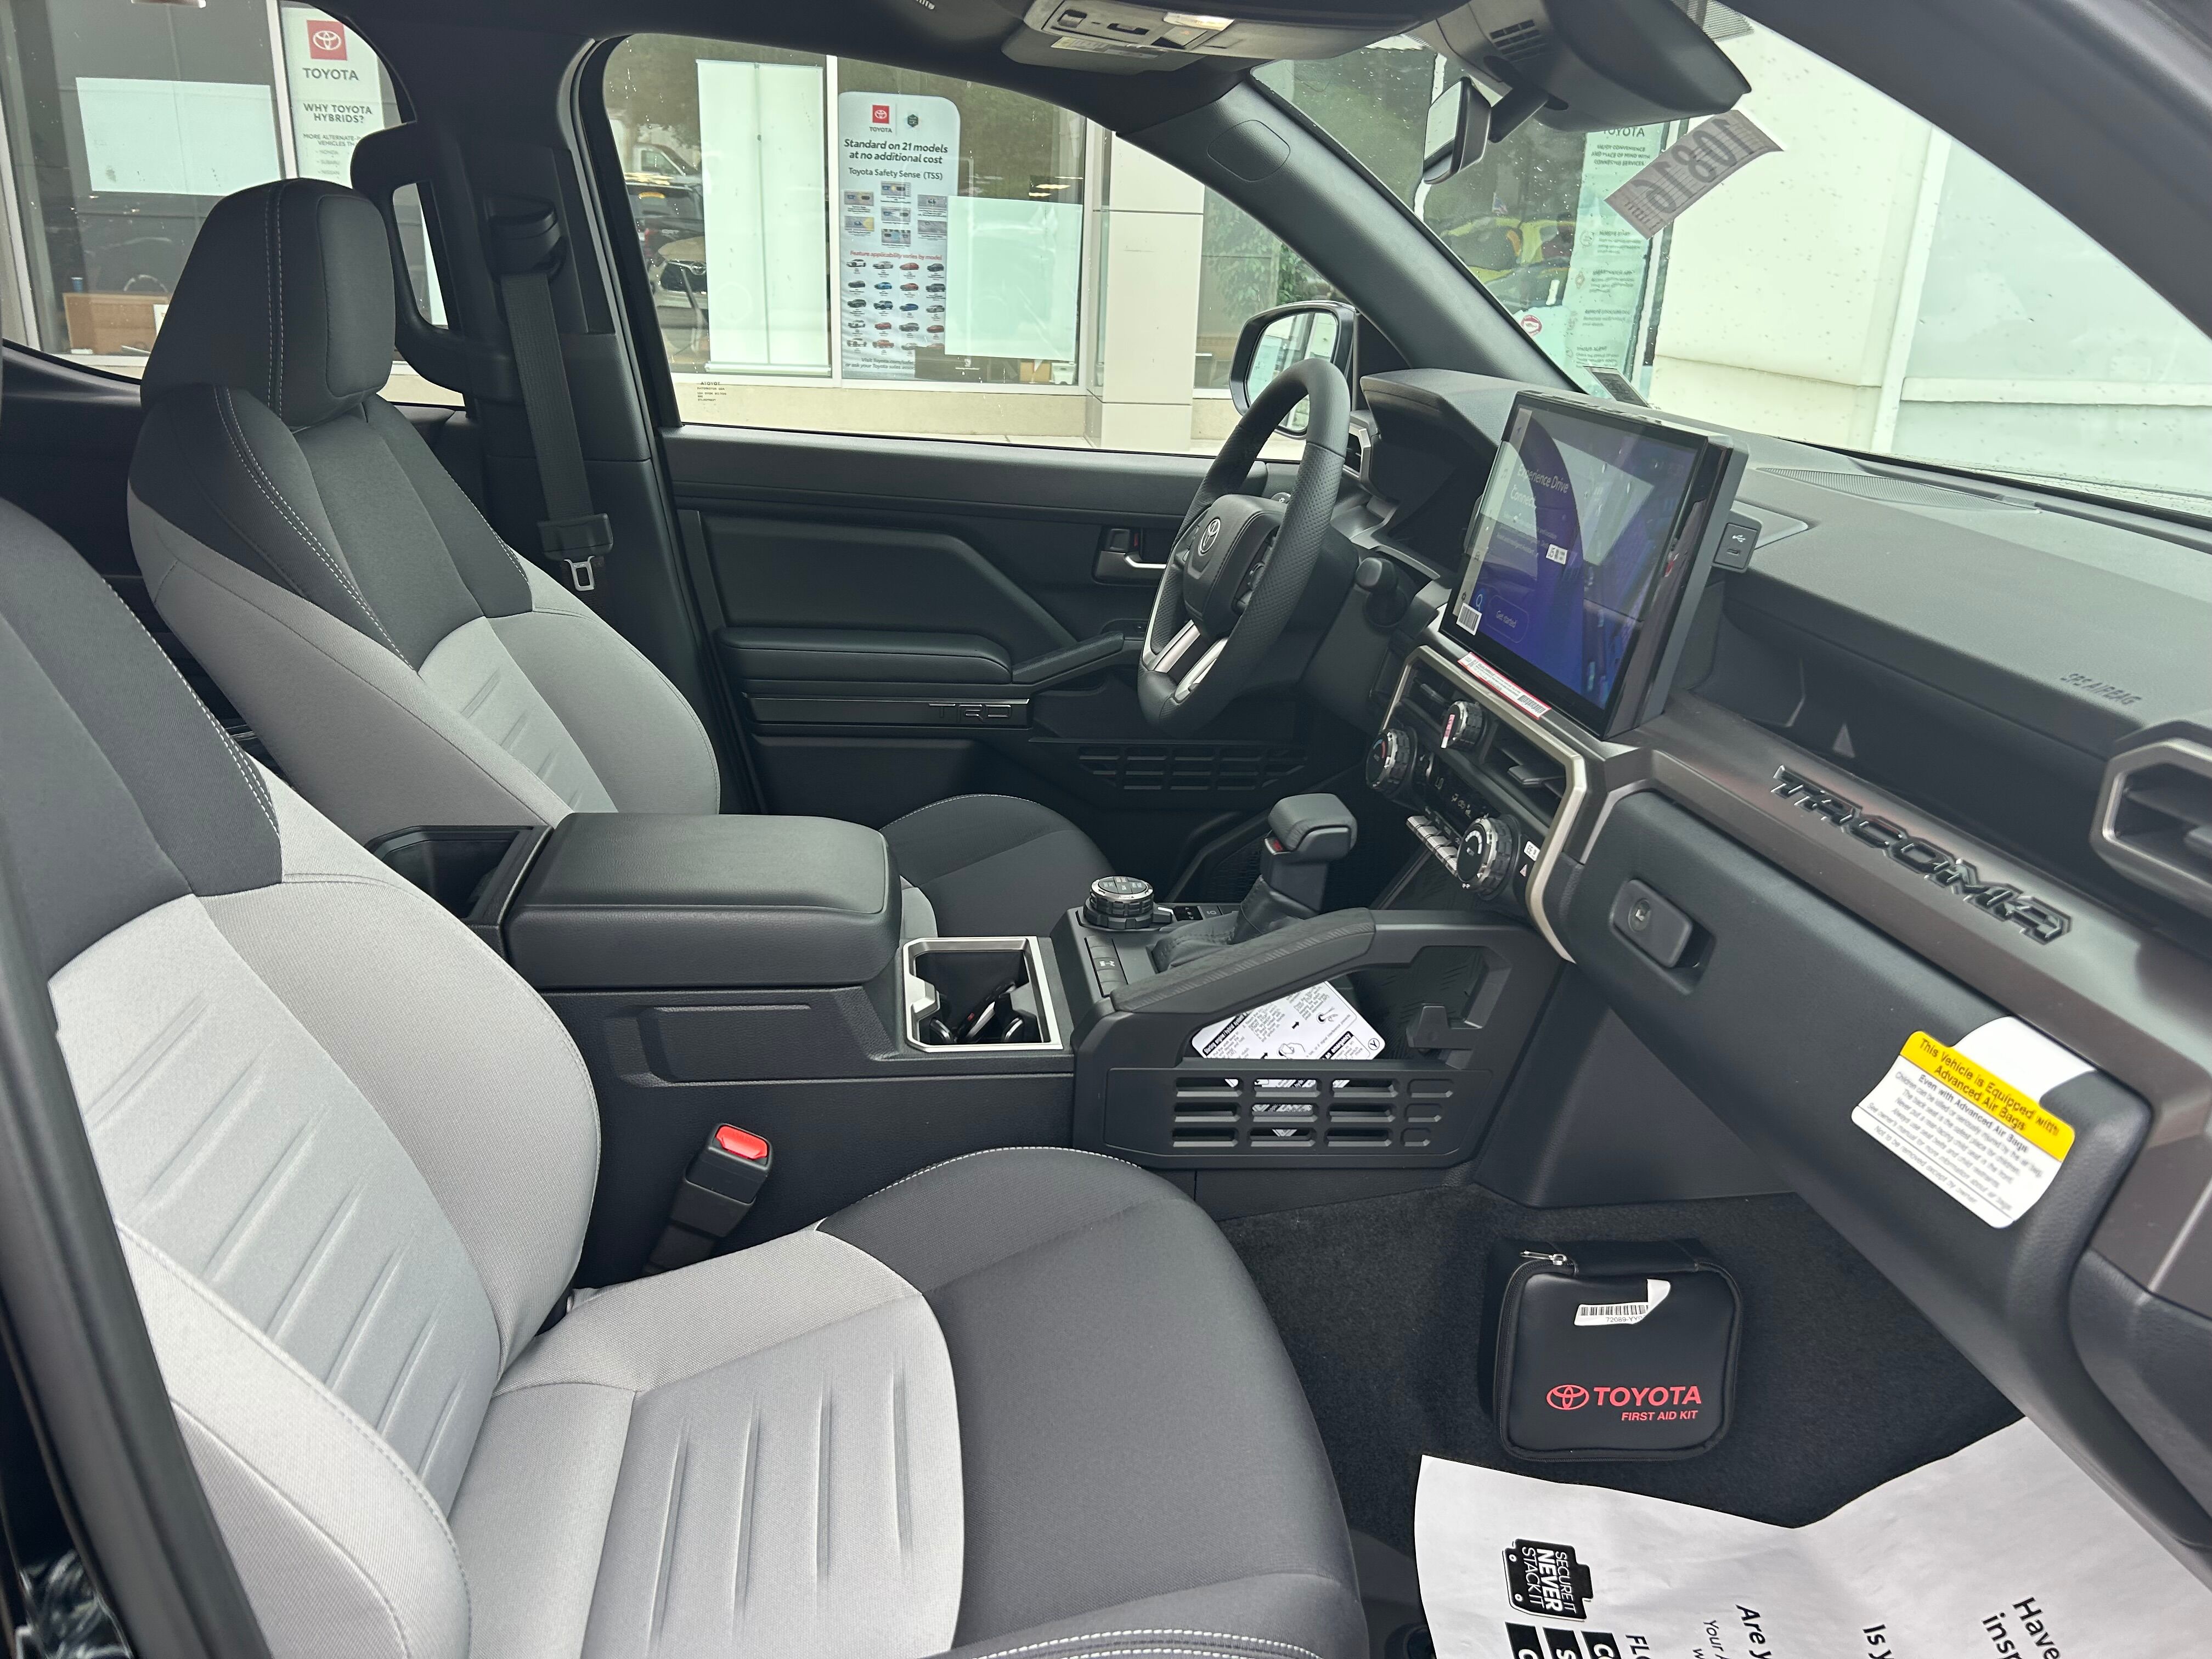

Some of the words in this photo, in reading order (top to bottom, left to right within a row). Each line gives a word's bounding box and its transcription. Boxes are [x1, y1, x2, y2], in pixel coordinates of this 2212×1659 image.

[302, 67, 359, 81] TOYOTA
[303, 103, 328, 111] WHY
[331, 104, 373, 114] TOYOTA
[314, 113, 364, 123] HYBRIDS?
[844, 139, 887, 149] Standard
[902, 142, 912, 150] 21
[913, 143, 949, 153] models
[849, 151, 859, 159] at
[874, 152, 921, 162] additional
[923, 156, 943, 164] cost
[848, 167, 873, 176] Toyota
[874, 169, 898, 178] Safety
[923, 172, 943, 180] (TSS)
[1517, 467, 1551, 487] Experience
[1551, 475, 1569, 493] Drive
[2081, 682, 2142, 705] AIRBAG
[1770, 765, 2072, 945] TACOMA
[1331, 1032, 1351, 1053] emergency
[1920, 1039, 1939, 1057] This
[1940, 1052, 1974, 1080] Vehicle
[1974, 1074, 1985, 1087] is
[1985, 1082, 2034, 1122] Equipped
[2035, 1114, 2059, 1136] with
[1935, 1065, 1982, 1101] Advanced
[1983, 1097, 1997, 1111] Air
[1999, 1108, 2025, 1133] Bags
[1919, 1074, 1937, 1090] Even
[1938, 1087, 1954, 1102] with
[1955, 1099, 1992, 1128] Advanced
[1994, 1125, 2006, 1137] Air
[2006, 1134, 2028, 1154] Bags
[1593, 1386, 1702, 1407] TOYOTA
[1621, 1412, 1655, 1421] FIRST
[1657, 1411, 1677, 1420] AID
[1680, 1410, 1698, 1420] KIT
[1522, 1547, 1541, 1595] STACK
[1537, 1548, 1564, 1612] NEVER
[1555, 1551, 1573, 1601] SECURE
[1530, 1594, 1545, 1609] IT
[1563, 1600, 1577, 1614] IT
[1735, 1604, 1766, 1645] Are
[1862, 1624, 1886, 1646] Is
[2012, 1597, 2061, 1659] Have
[1703, 1620, 1724, 1652] Your
